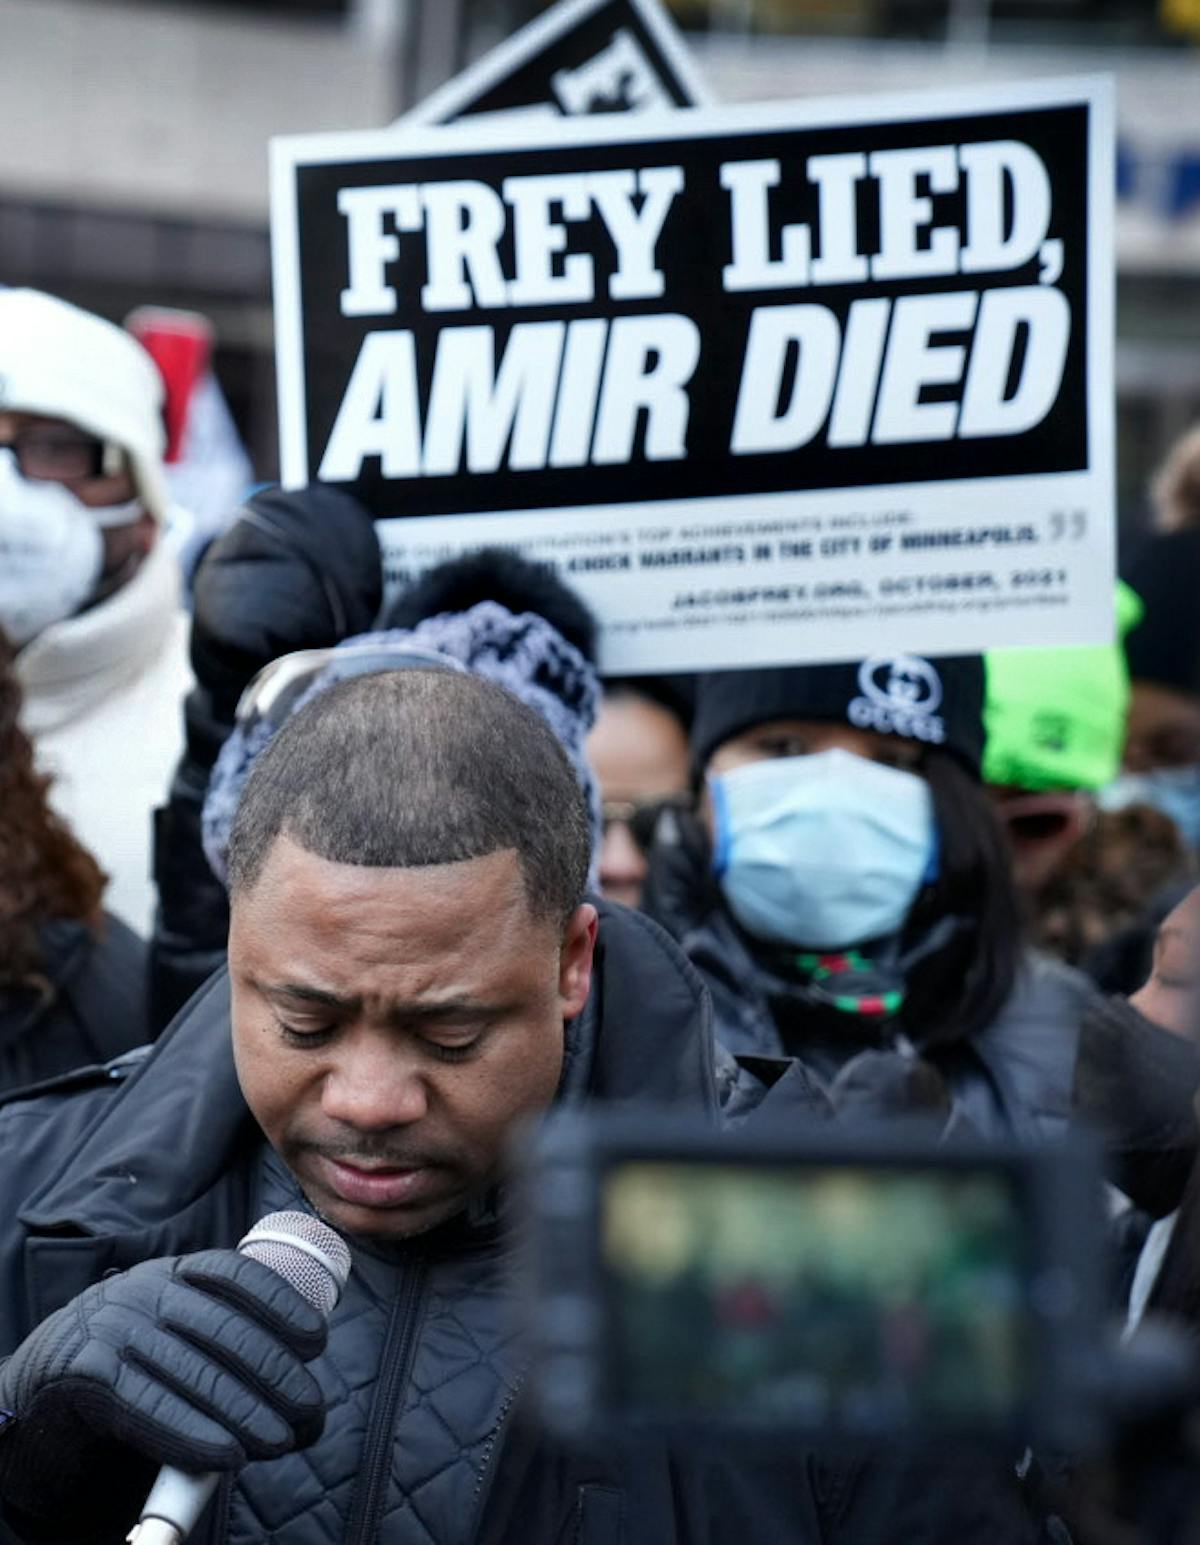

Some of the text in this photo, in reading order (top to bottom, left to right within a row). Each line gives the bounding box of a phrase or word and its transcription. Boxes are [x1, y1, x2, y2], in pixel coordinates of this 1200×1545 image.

[337, 165, 684, 317] FREY
[720, 139, 1065, 291] LIED,
[318, 285, 1072, 482] AMIR DIED
[640, 545, 745, 568] WARRANTS
[753, 541, 771, 560] IN
[779, 538, 813, 558] THE
[820, 534, 860, 556] CITY
[868, 533, 892, 552] OF
[900, 526, 1037, 549] MINNEAPOLIS.
